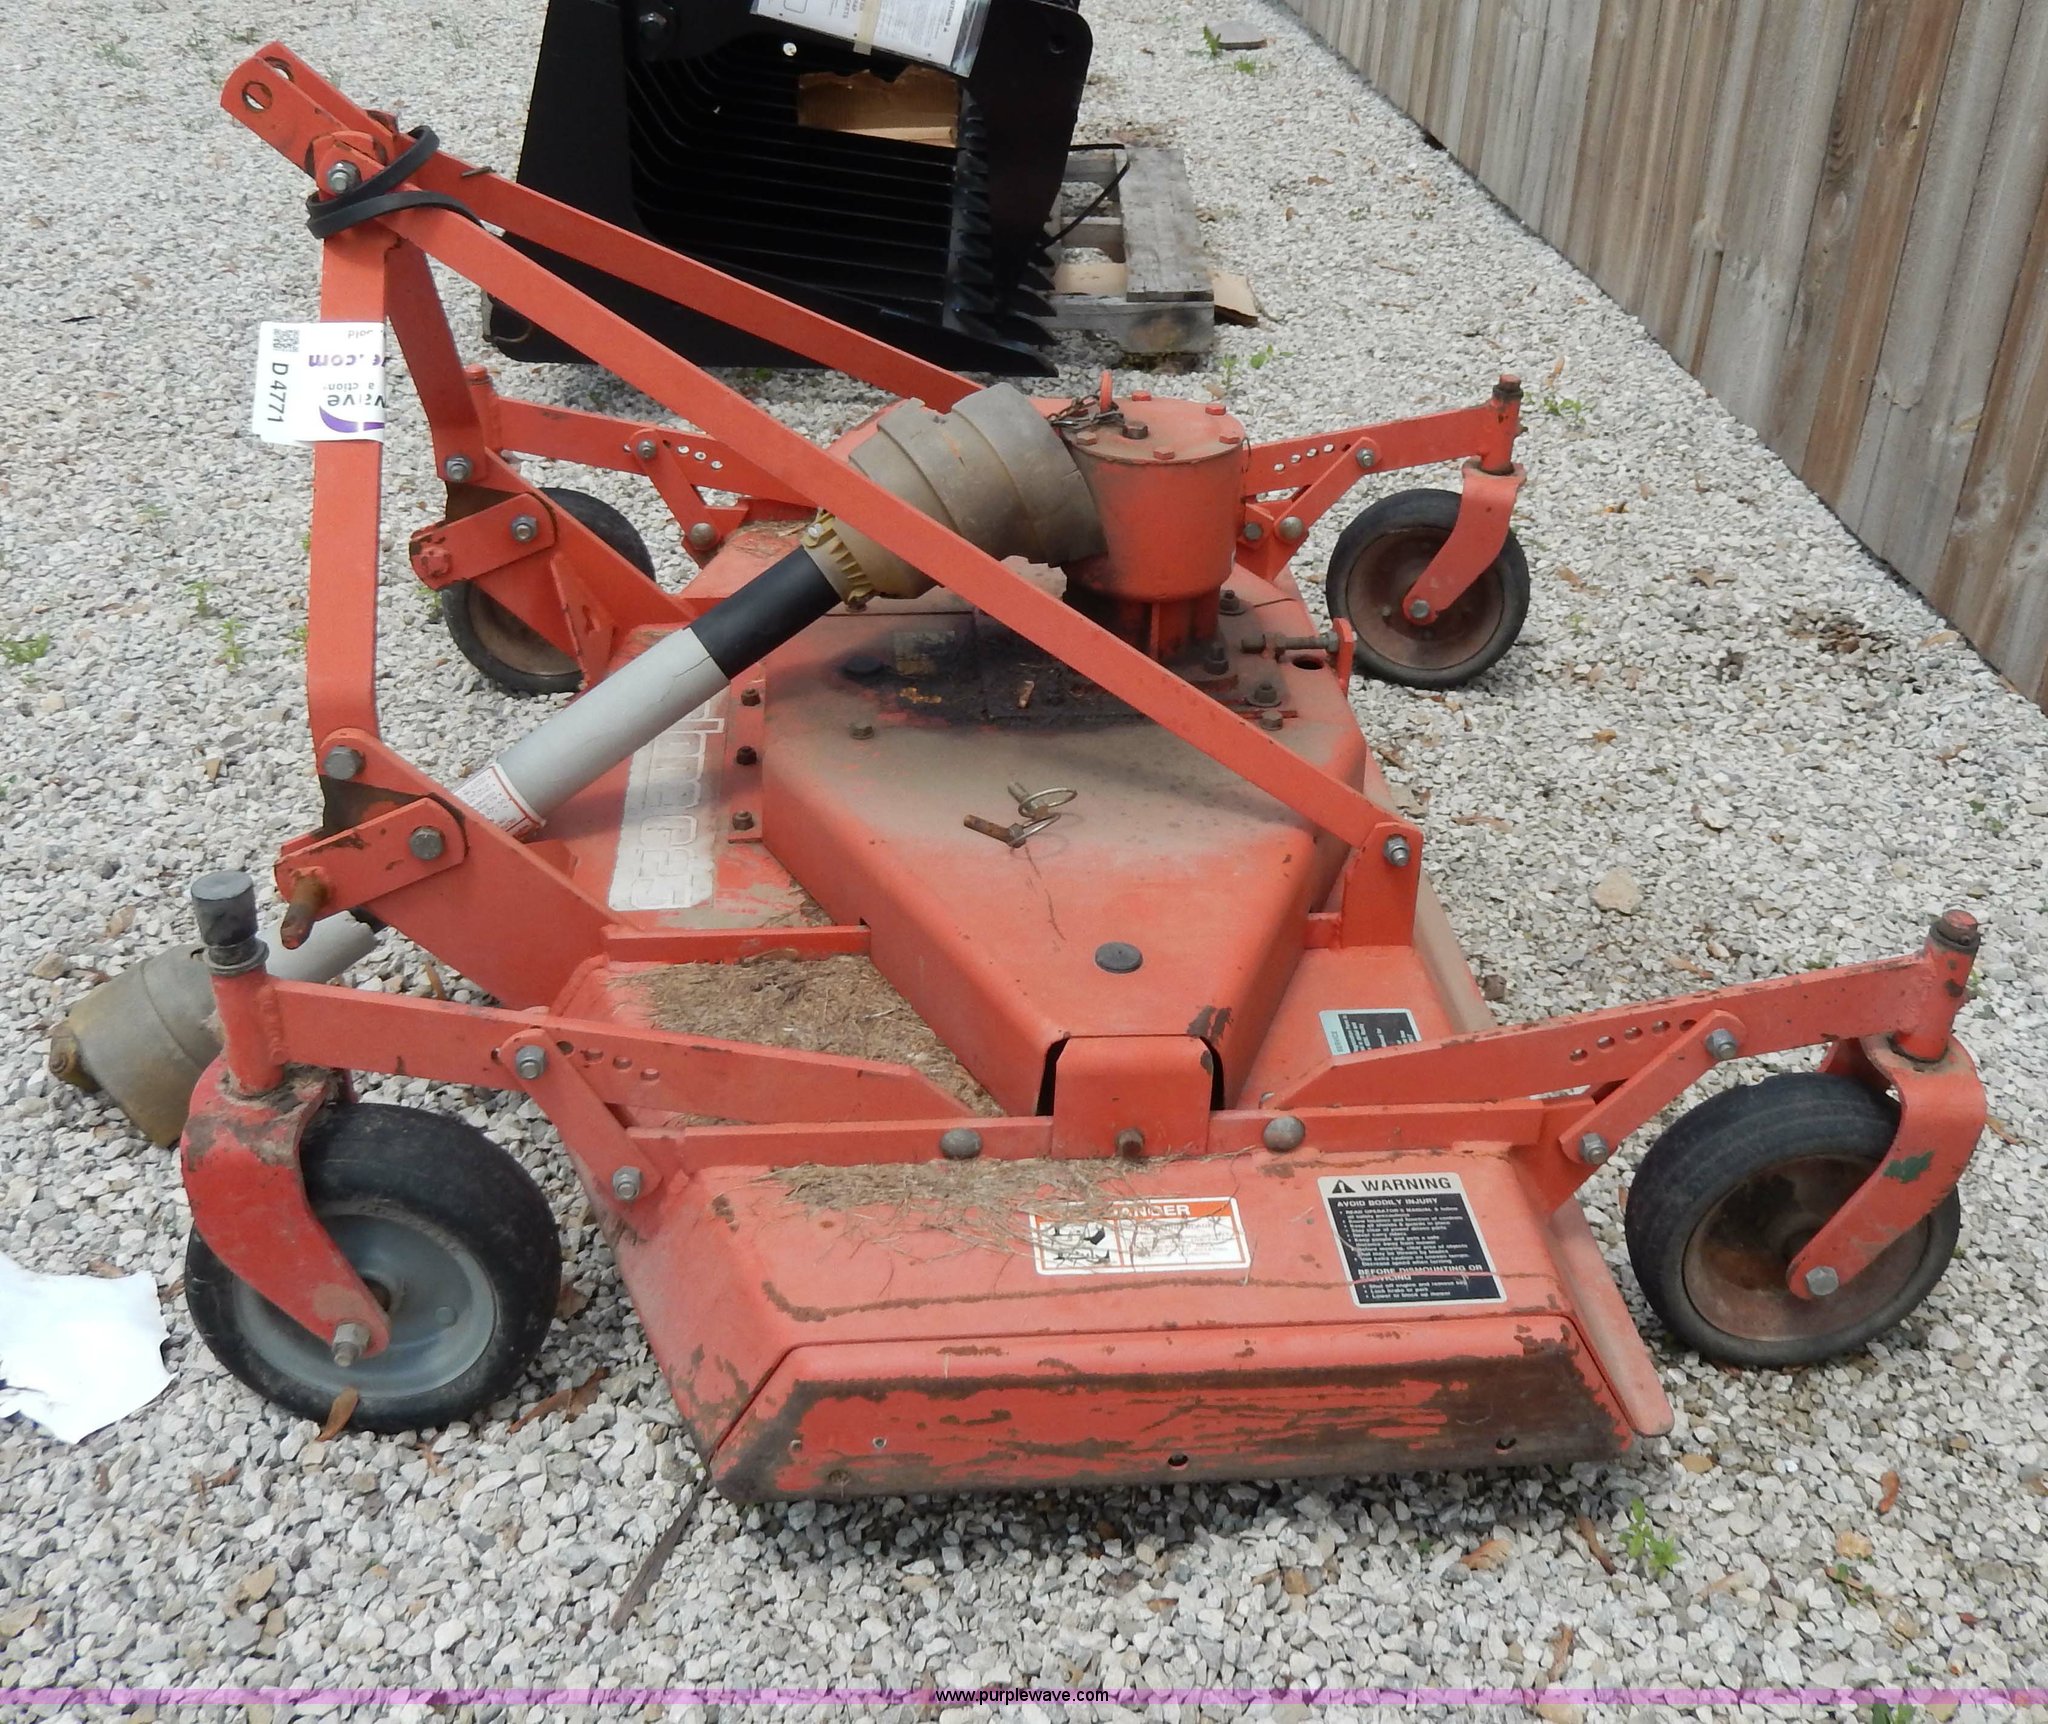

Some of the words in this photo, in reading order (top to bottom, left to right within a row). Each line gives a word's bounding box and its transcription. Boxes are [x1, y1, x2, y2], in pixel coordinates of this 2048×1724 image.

[271, 362, 289, 376] D
[267, 380, 287, 423] 4771
[1361, 1177, 1452, 1192] WARNING
[1368, 1199, 1402, 1207] BODILY
